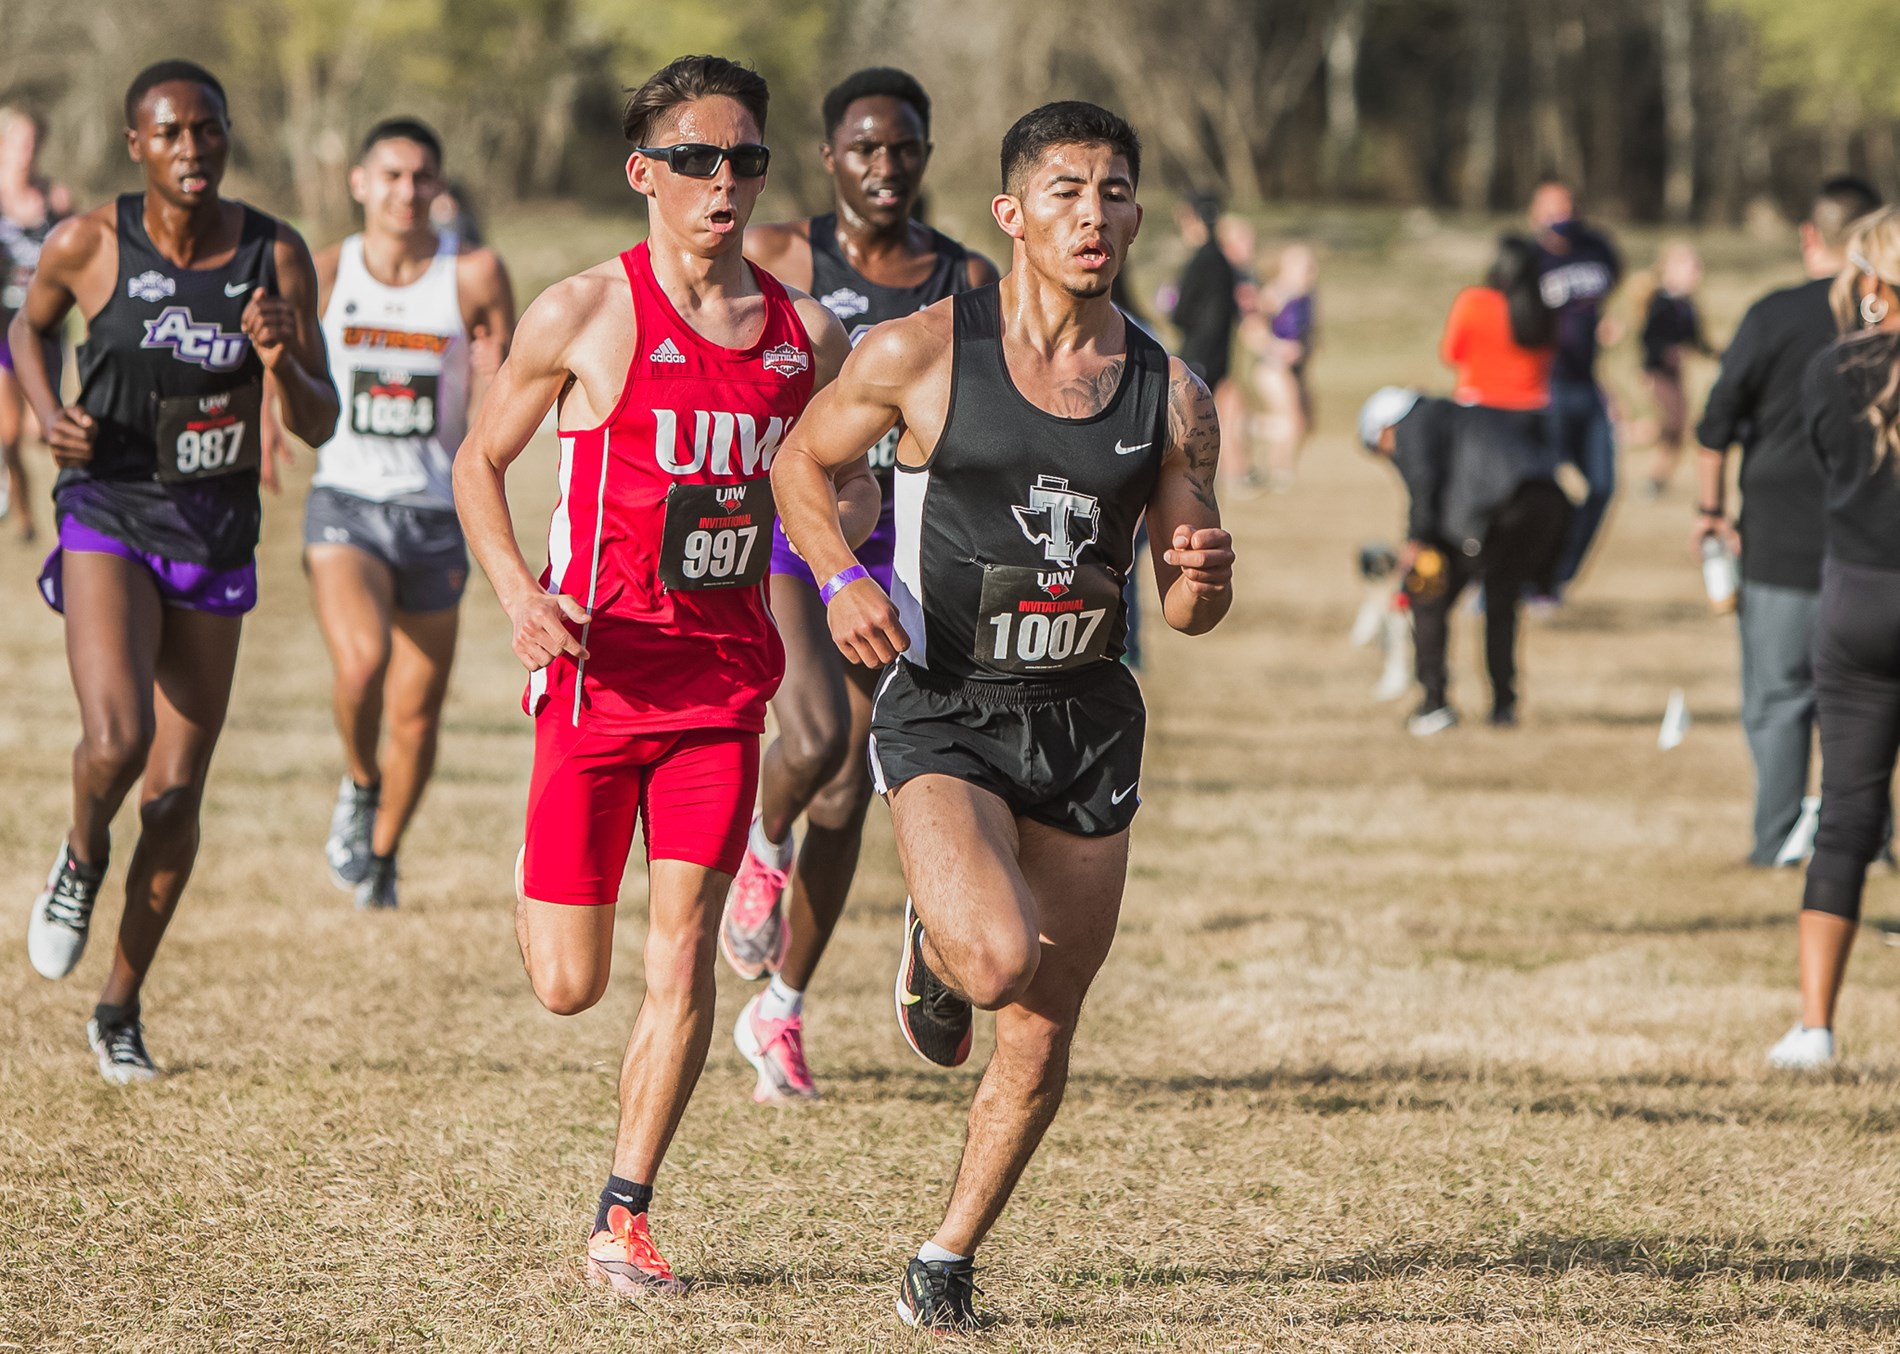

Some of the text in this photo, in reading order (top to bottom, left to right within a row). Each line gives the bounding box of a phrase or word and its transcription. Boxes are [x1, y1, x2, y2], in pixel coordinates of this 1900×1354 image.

[146, 308, 249, 370] ACU
[650, 353, 686, 363] adidas
[176, 421, 246, 474] 987
[651, 409, 794, 476] UIW
[716, 486, 747, 502] UIW
[699, 514, 751, 529] INVITATIONAL
[682, 526, 758, 579] 997
[1037, 570, 1075, 587] UIW
[1018, 599, 1084, 613] INVITATIONAL
[990, 608, 1107, 662] 1007
